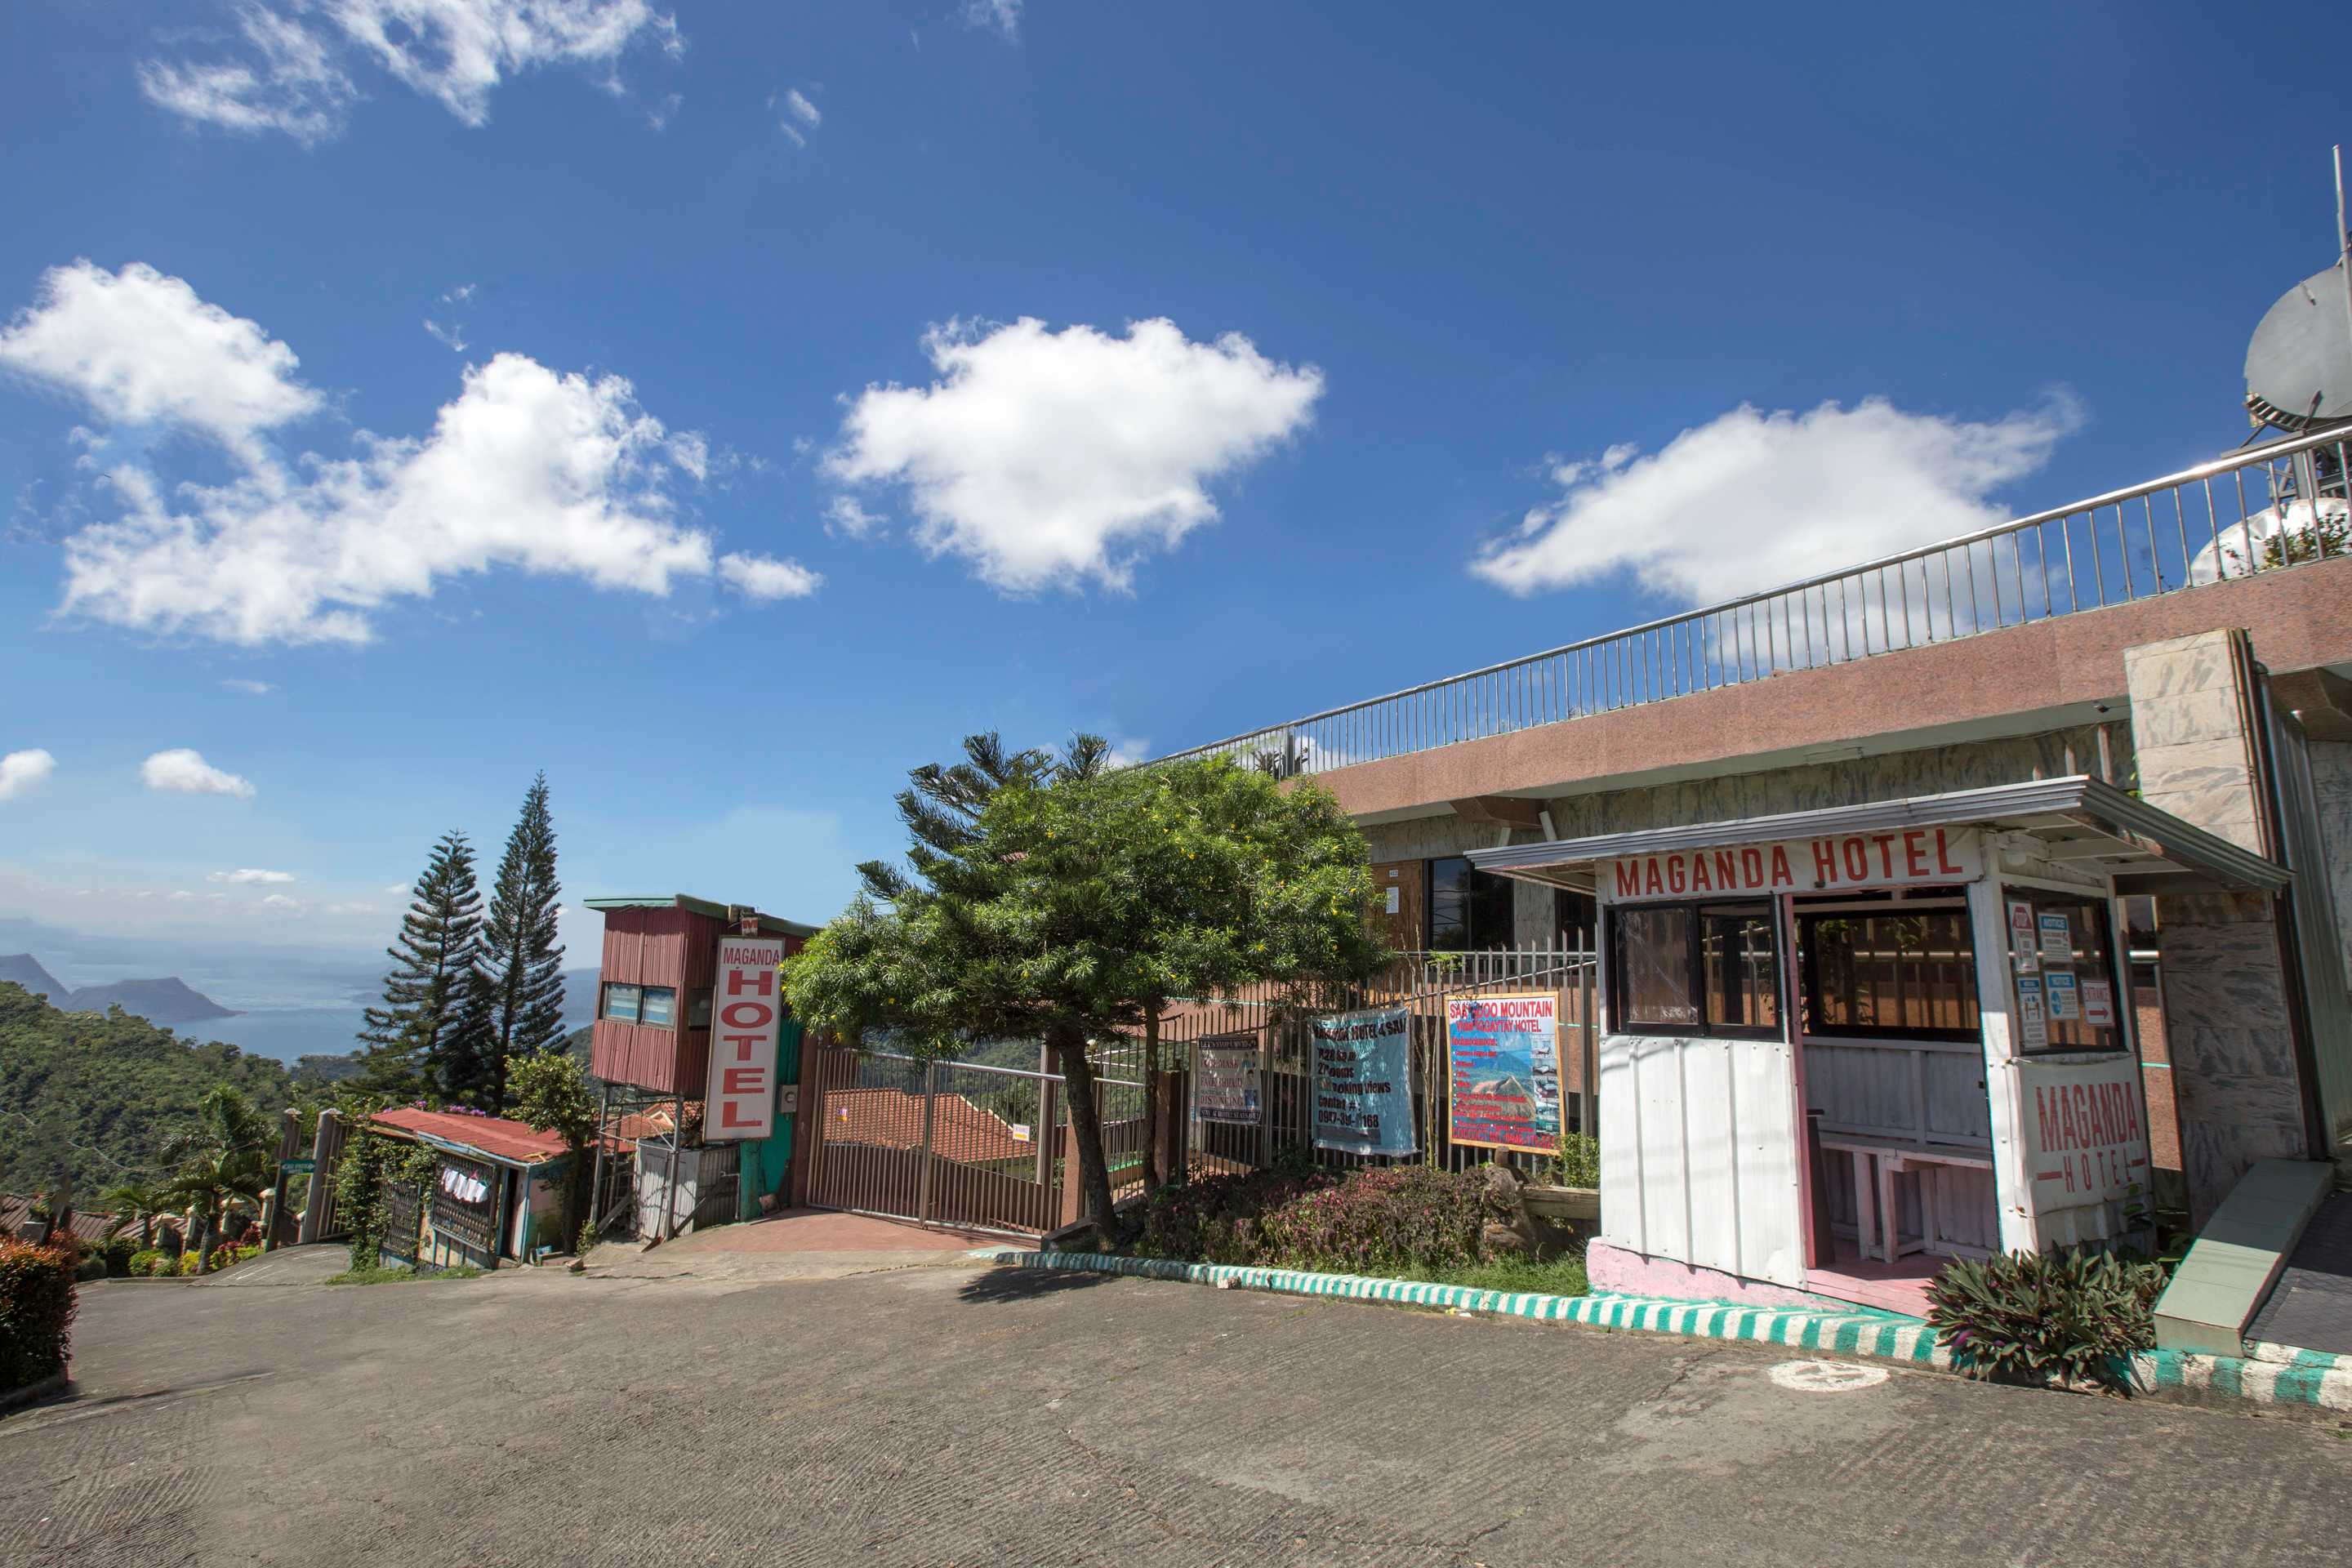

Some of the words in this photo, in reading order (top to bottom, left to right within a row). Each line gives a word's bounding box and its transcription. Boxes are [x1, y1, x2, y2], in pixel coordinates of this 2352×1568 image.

[1615, 845, 1793, 898] MAGANDA
[1811, 829, 1963, 883] HOTEL
[2042, 919, 2065, 929] NOTICE
[724, 947, 780, 966] MAGANDA
[1501, 1000, 1552, 1018] MOUNTAIN
[1352, 1023, 1378, 1040] HOTEL
[1515, 1019, 1542, 1032] HOTEL
[720, 969, 773, 1128] HOTEL
[1365, 1080, 1392, 1094] views
[2035, 1081, 2140, 1152] MAGANDA
[2063, 1147, 2132, 1193] HOTEL
